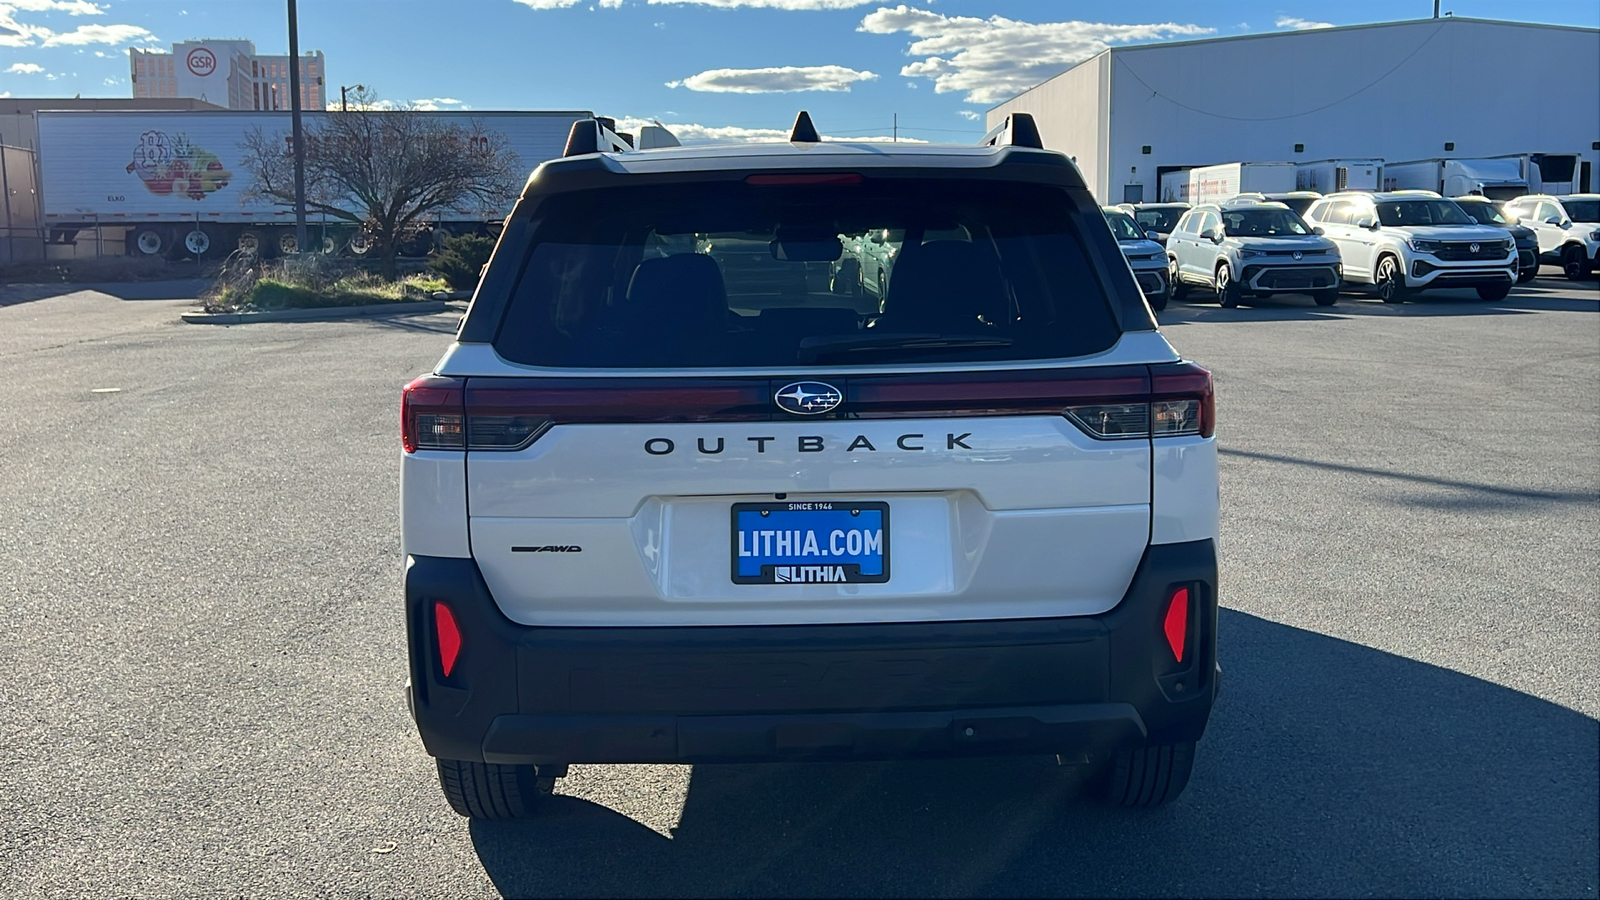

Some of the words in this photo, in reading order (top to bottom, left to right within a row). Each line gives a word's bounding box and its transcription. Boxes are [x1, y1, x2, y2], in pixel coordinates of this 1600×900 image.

[190, 56, 213, 69] GSR
[643, 431, 973, 456] OUTBACK
[788, 503, 813, 511] SINCE
[537, 545, 583, 553] AWD
[738, 529, 884, 557] LITHIA.COM
[791, 566, 847, 583] LITHIA
